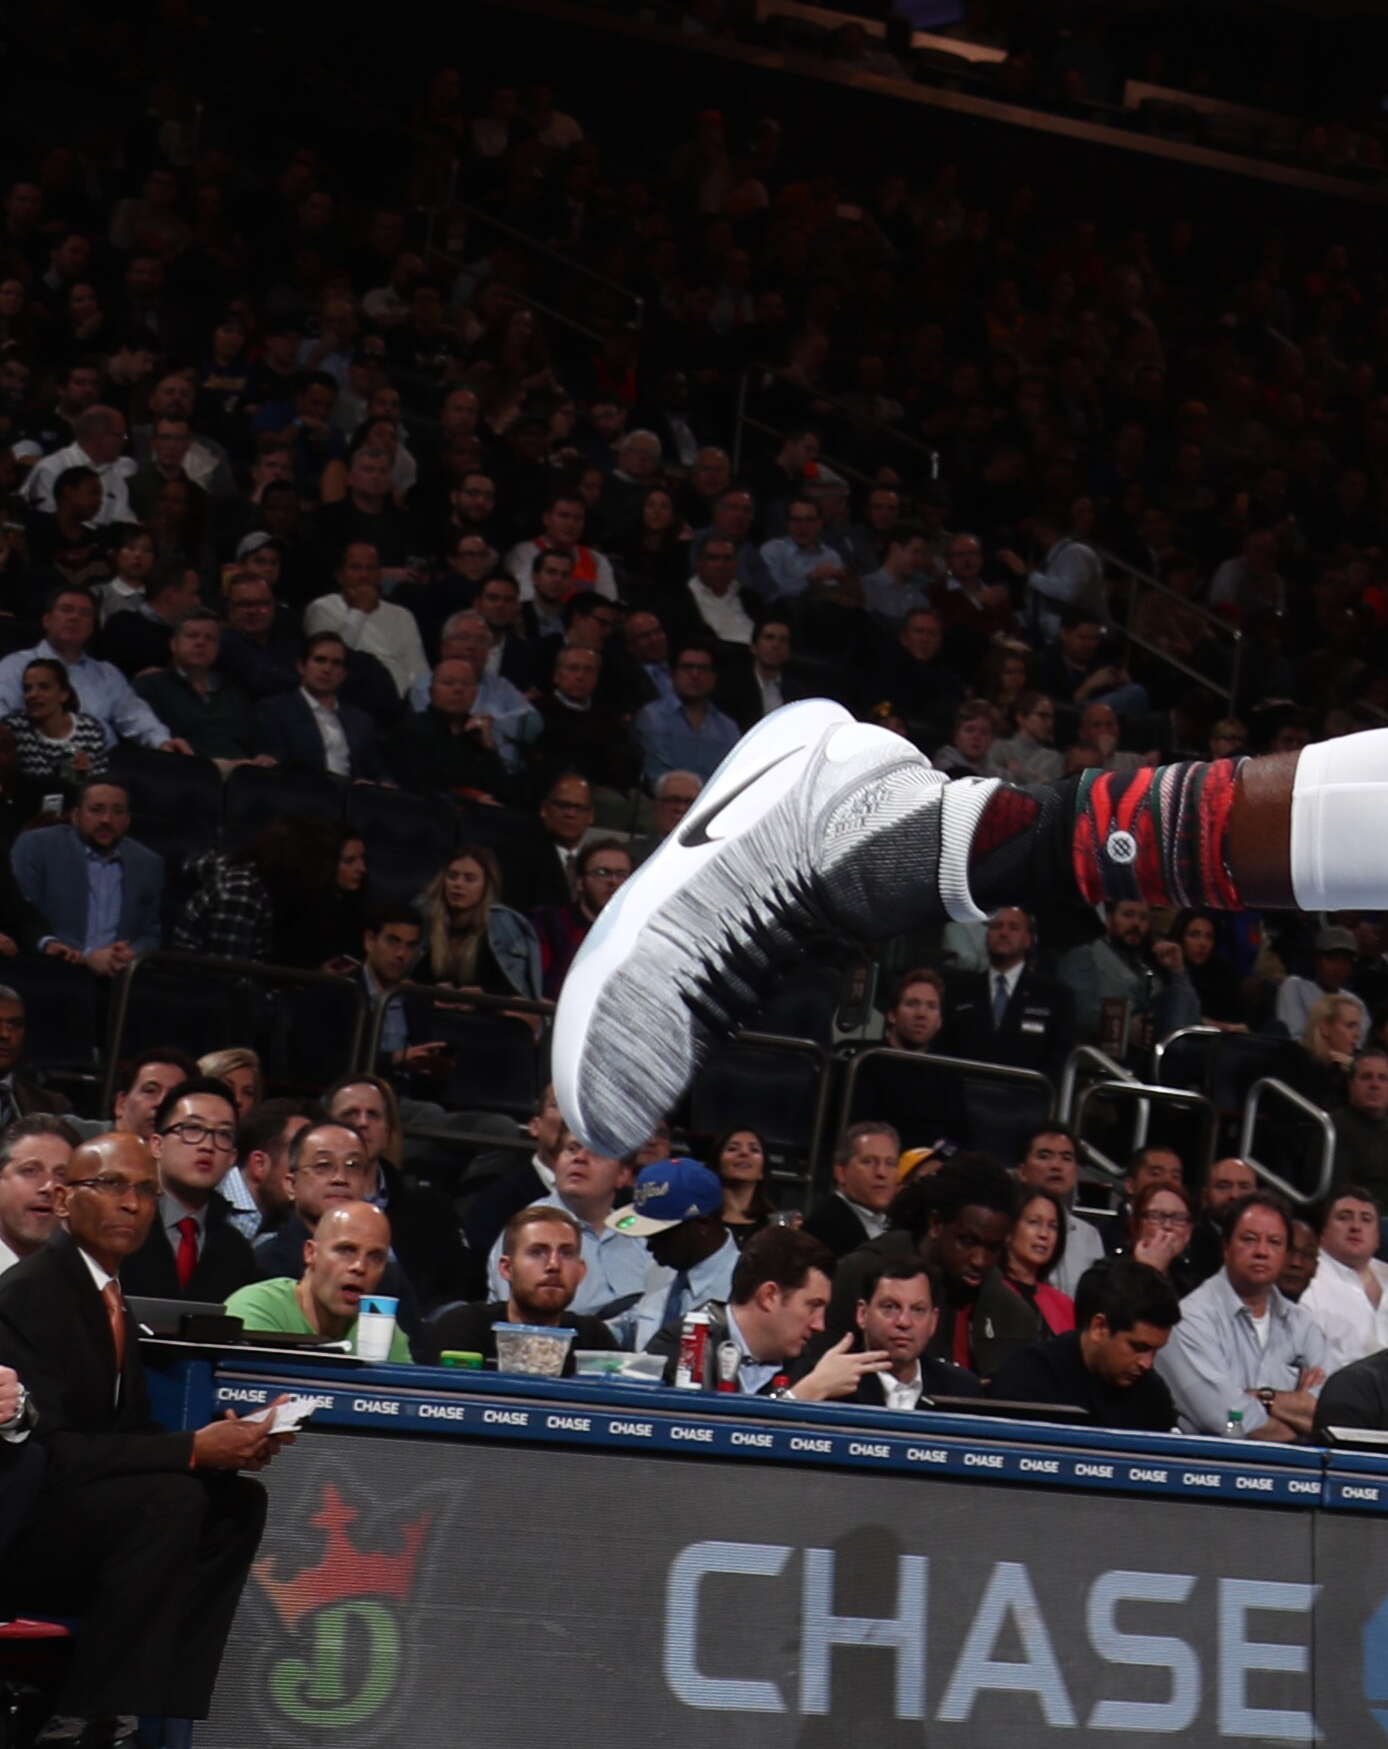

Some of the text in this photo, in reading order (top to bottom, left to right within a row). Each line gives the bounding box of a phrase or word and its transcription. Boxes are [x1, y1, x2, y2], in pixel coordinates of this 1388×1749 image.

[217, 1387, 267, 1404] CHASE
[353, 1399, 400, 1415] CHASE
[418, 1404, 465, 1420] CHASE
[483, 1409, 529, 1426] CHASE
[546, 1415, 592, 1432] CHASE
[608, 1421, 653, 1437] CHASE
[670, 1426, 714, 1442] CHASE
[730, 1432, 774, 1448] CHASE
[790, 1437, 833, 1453] CHASE
[848, 1442, 891, 1458] CHASE
[906, 1448, 948, 1463] CHASE
[963, 1453, 1004, 1468] CHASE
[1019, 1458, 1060, 1473] CHASE
[1074, 1463, 1114, 1478] CHASE
[1129, 1468, 1168, 1483] CHASE
[1182, 1472, 1221, 1487] CHASE
[1235, 1476, 1274, 1491] CHASE
[1341, 1486, 1379, 1501] CHASE
[664, 1540, 1324, 1739] CHASE
